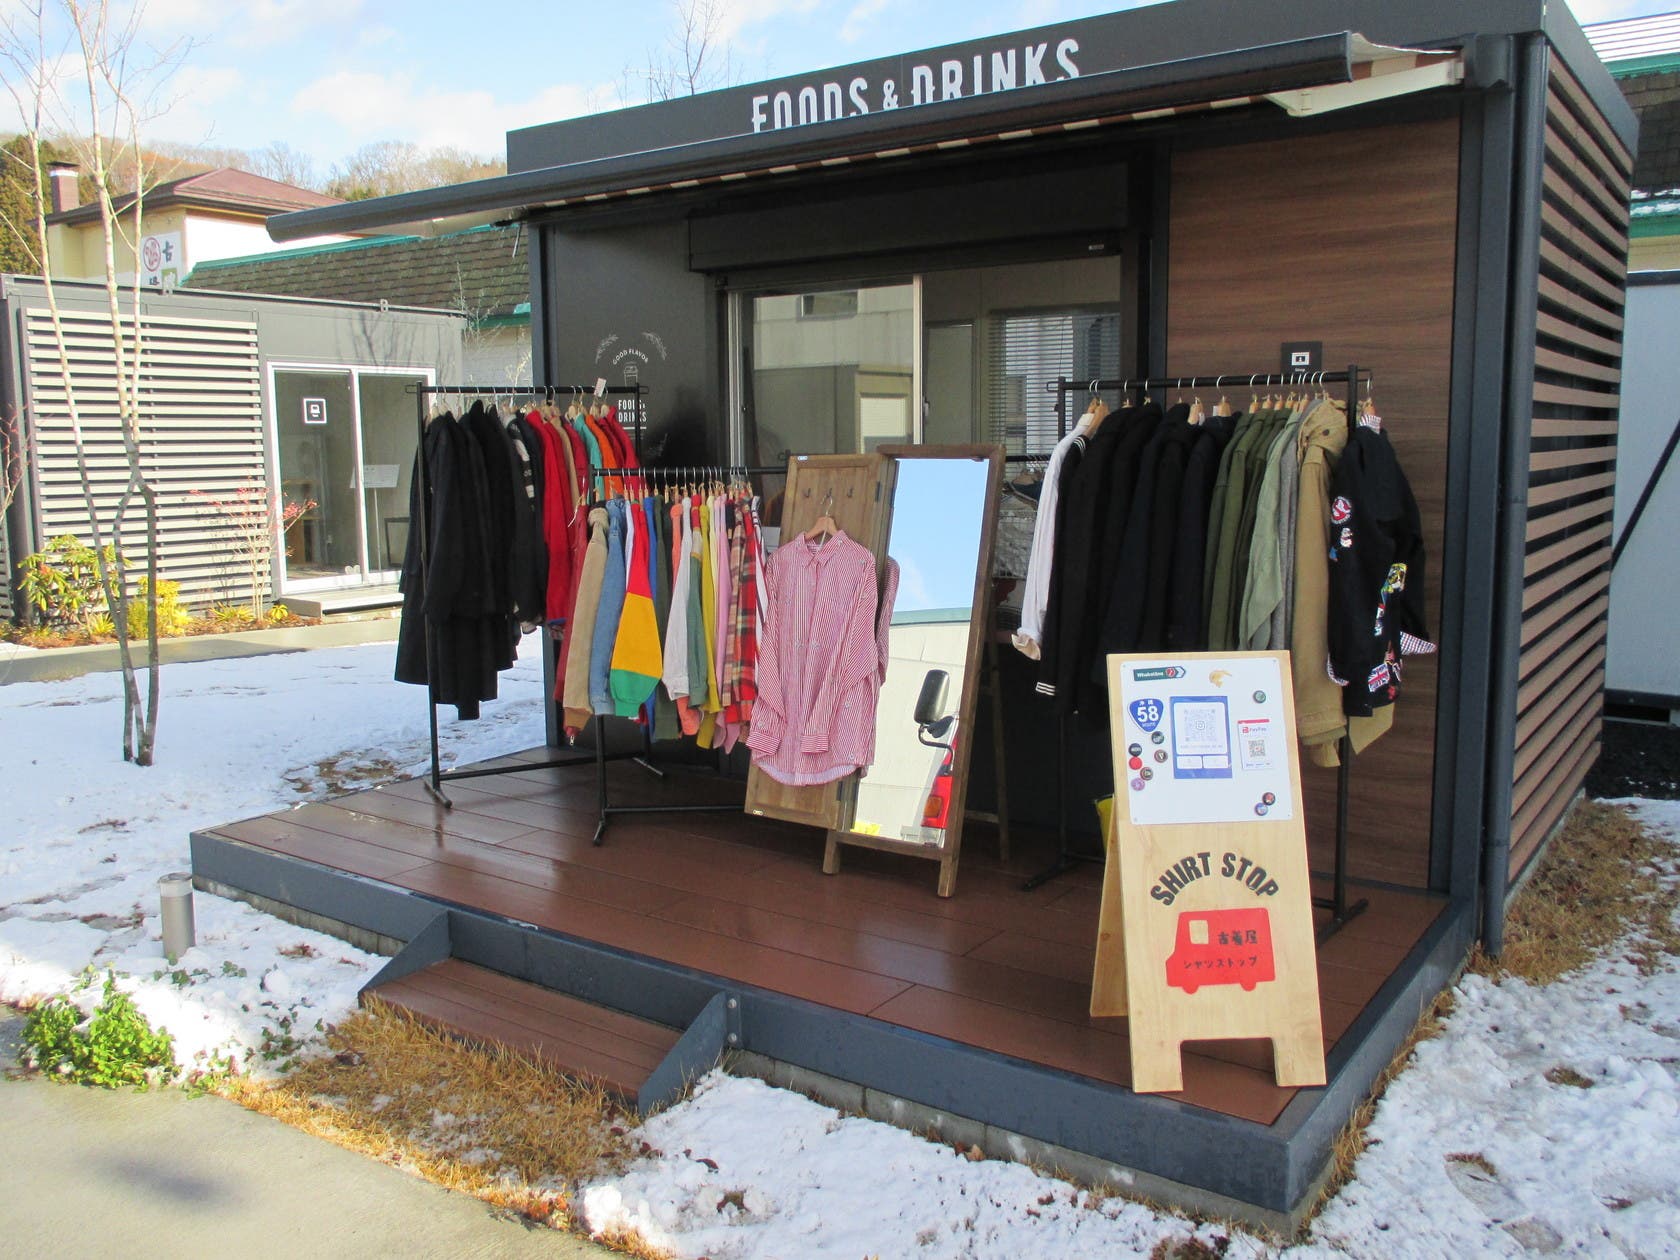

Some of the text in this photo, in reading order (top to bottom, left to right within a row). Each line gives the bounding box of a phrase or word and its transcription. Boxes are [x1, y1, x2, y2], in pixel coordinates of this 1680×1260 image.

[752, 39, 1080, 133] FOODS & DRINKS
[613, 348, 648, 365] GOOD FLAVOR
[618, 399, 642, 411] FOO
[1137, 705, 1160, 723] 58
[1150, 852, 1279, 906] SHIRT STOP
